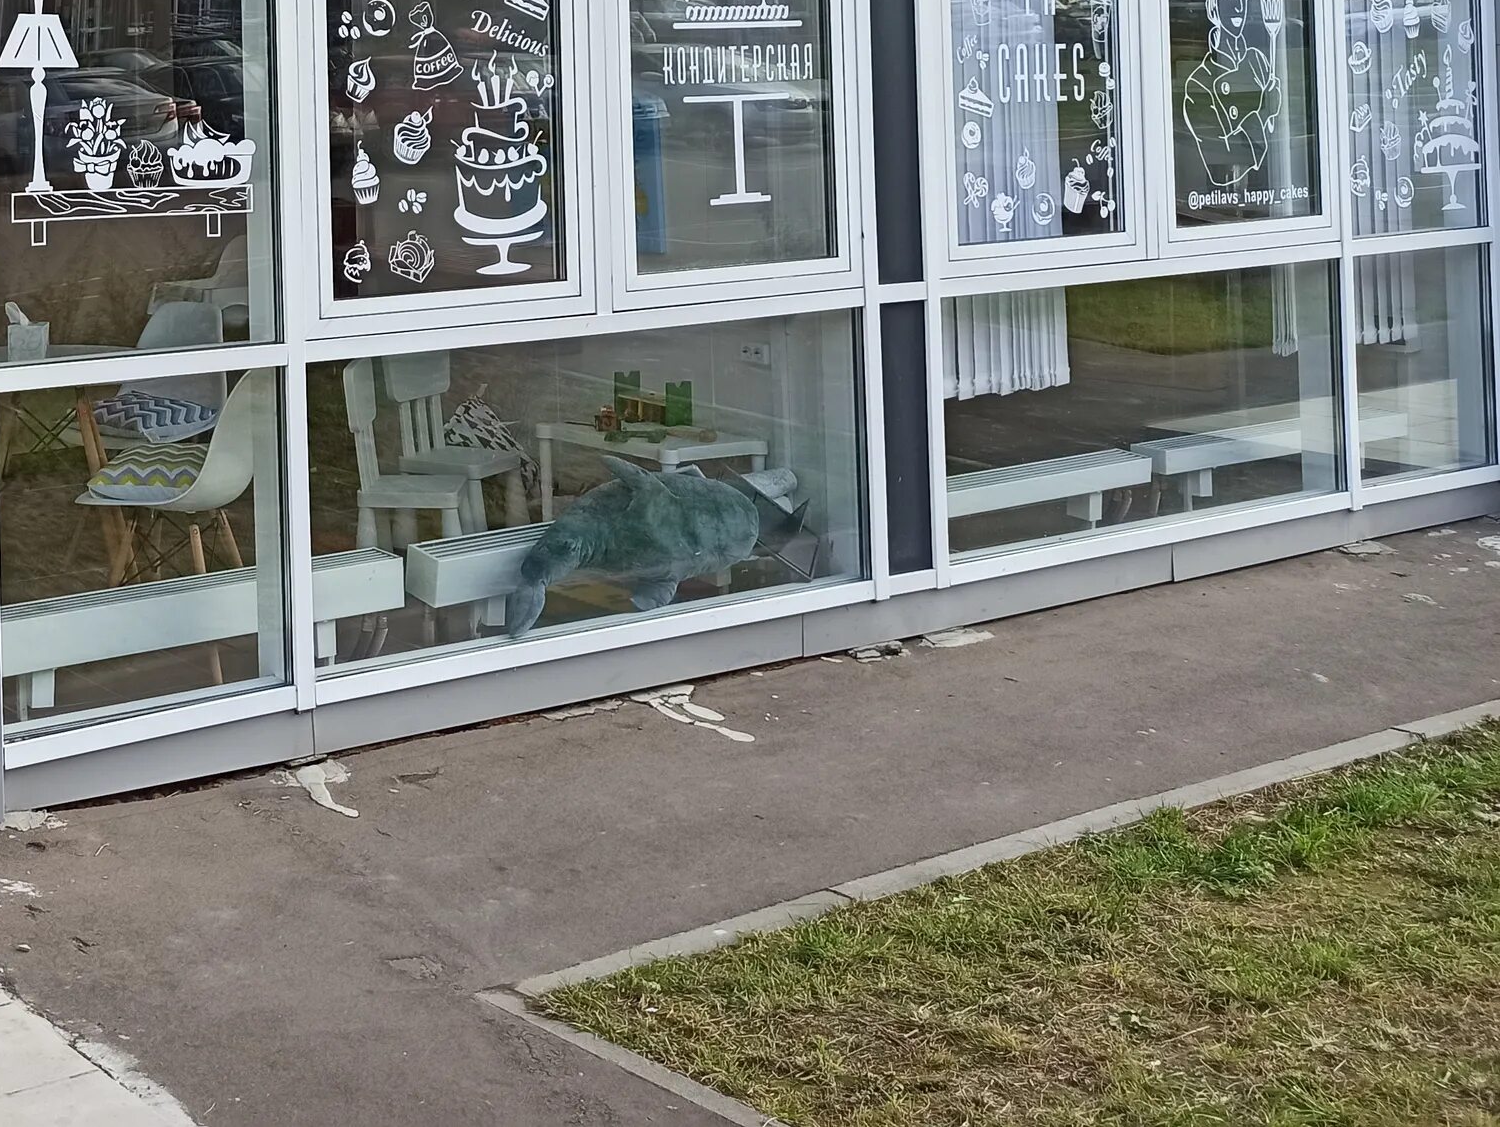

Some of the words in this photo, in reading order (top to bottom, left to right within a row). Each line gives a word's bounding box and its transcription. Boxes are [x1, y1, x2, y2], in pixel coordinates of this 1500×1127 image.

[470, 10, 549, 58] Delicious
[956, 34, 978, 64] Coffee
[662, 43, 814, 85] КОНДИТЕРСКАЯ
[998, 42, 1085, 104] CAKES
[1391, 48, 1428, 98] Tasty
[1188, 185, 1309, 210] @petilavs_happy_cakes
